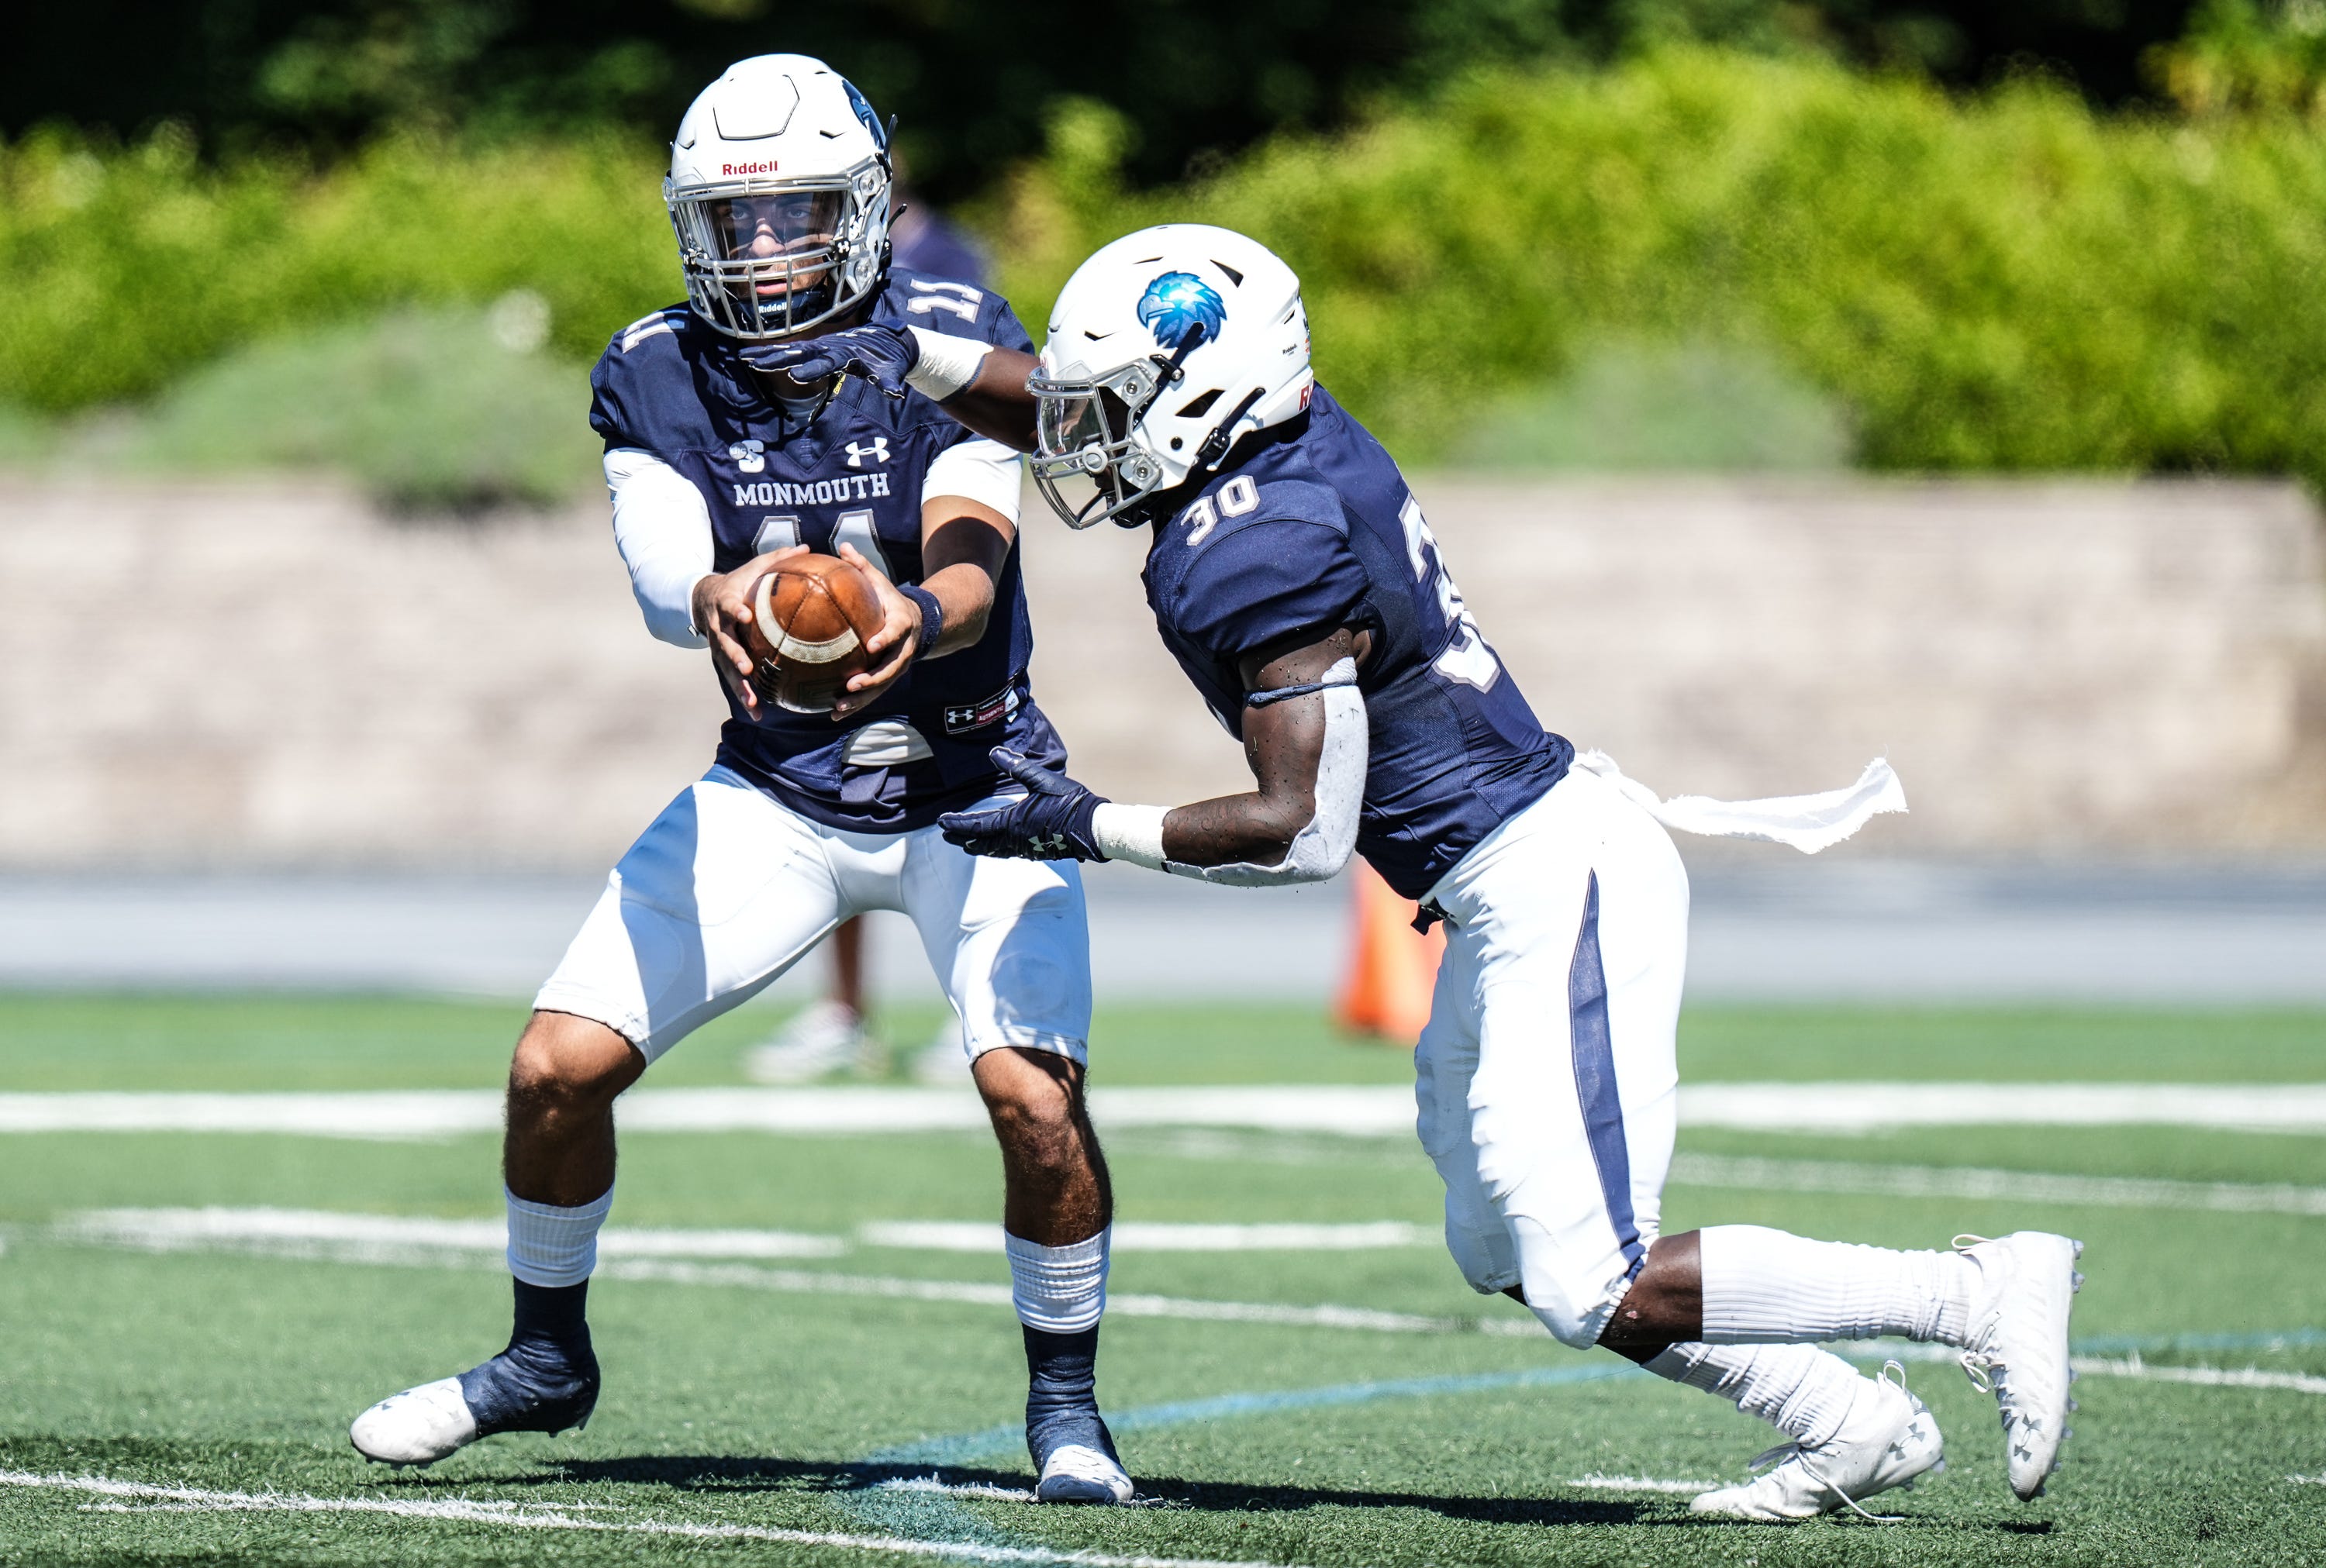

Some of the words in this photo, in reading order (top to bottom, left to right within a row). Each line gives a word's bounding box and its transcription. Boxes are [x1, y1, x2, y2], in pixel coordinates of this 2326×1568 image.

[722, 160, 778, 176] Riddell
[758, 302, 788, 313] Riddell
[733, 472, 890, 506] MONMOUTH
[1180, 474, 1261, 546] 30
